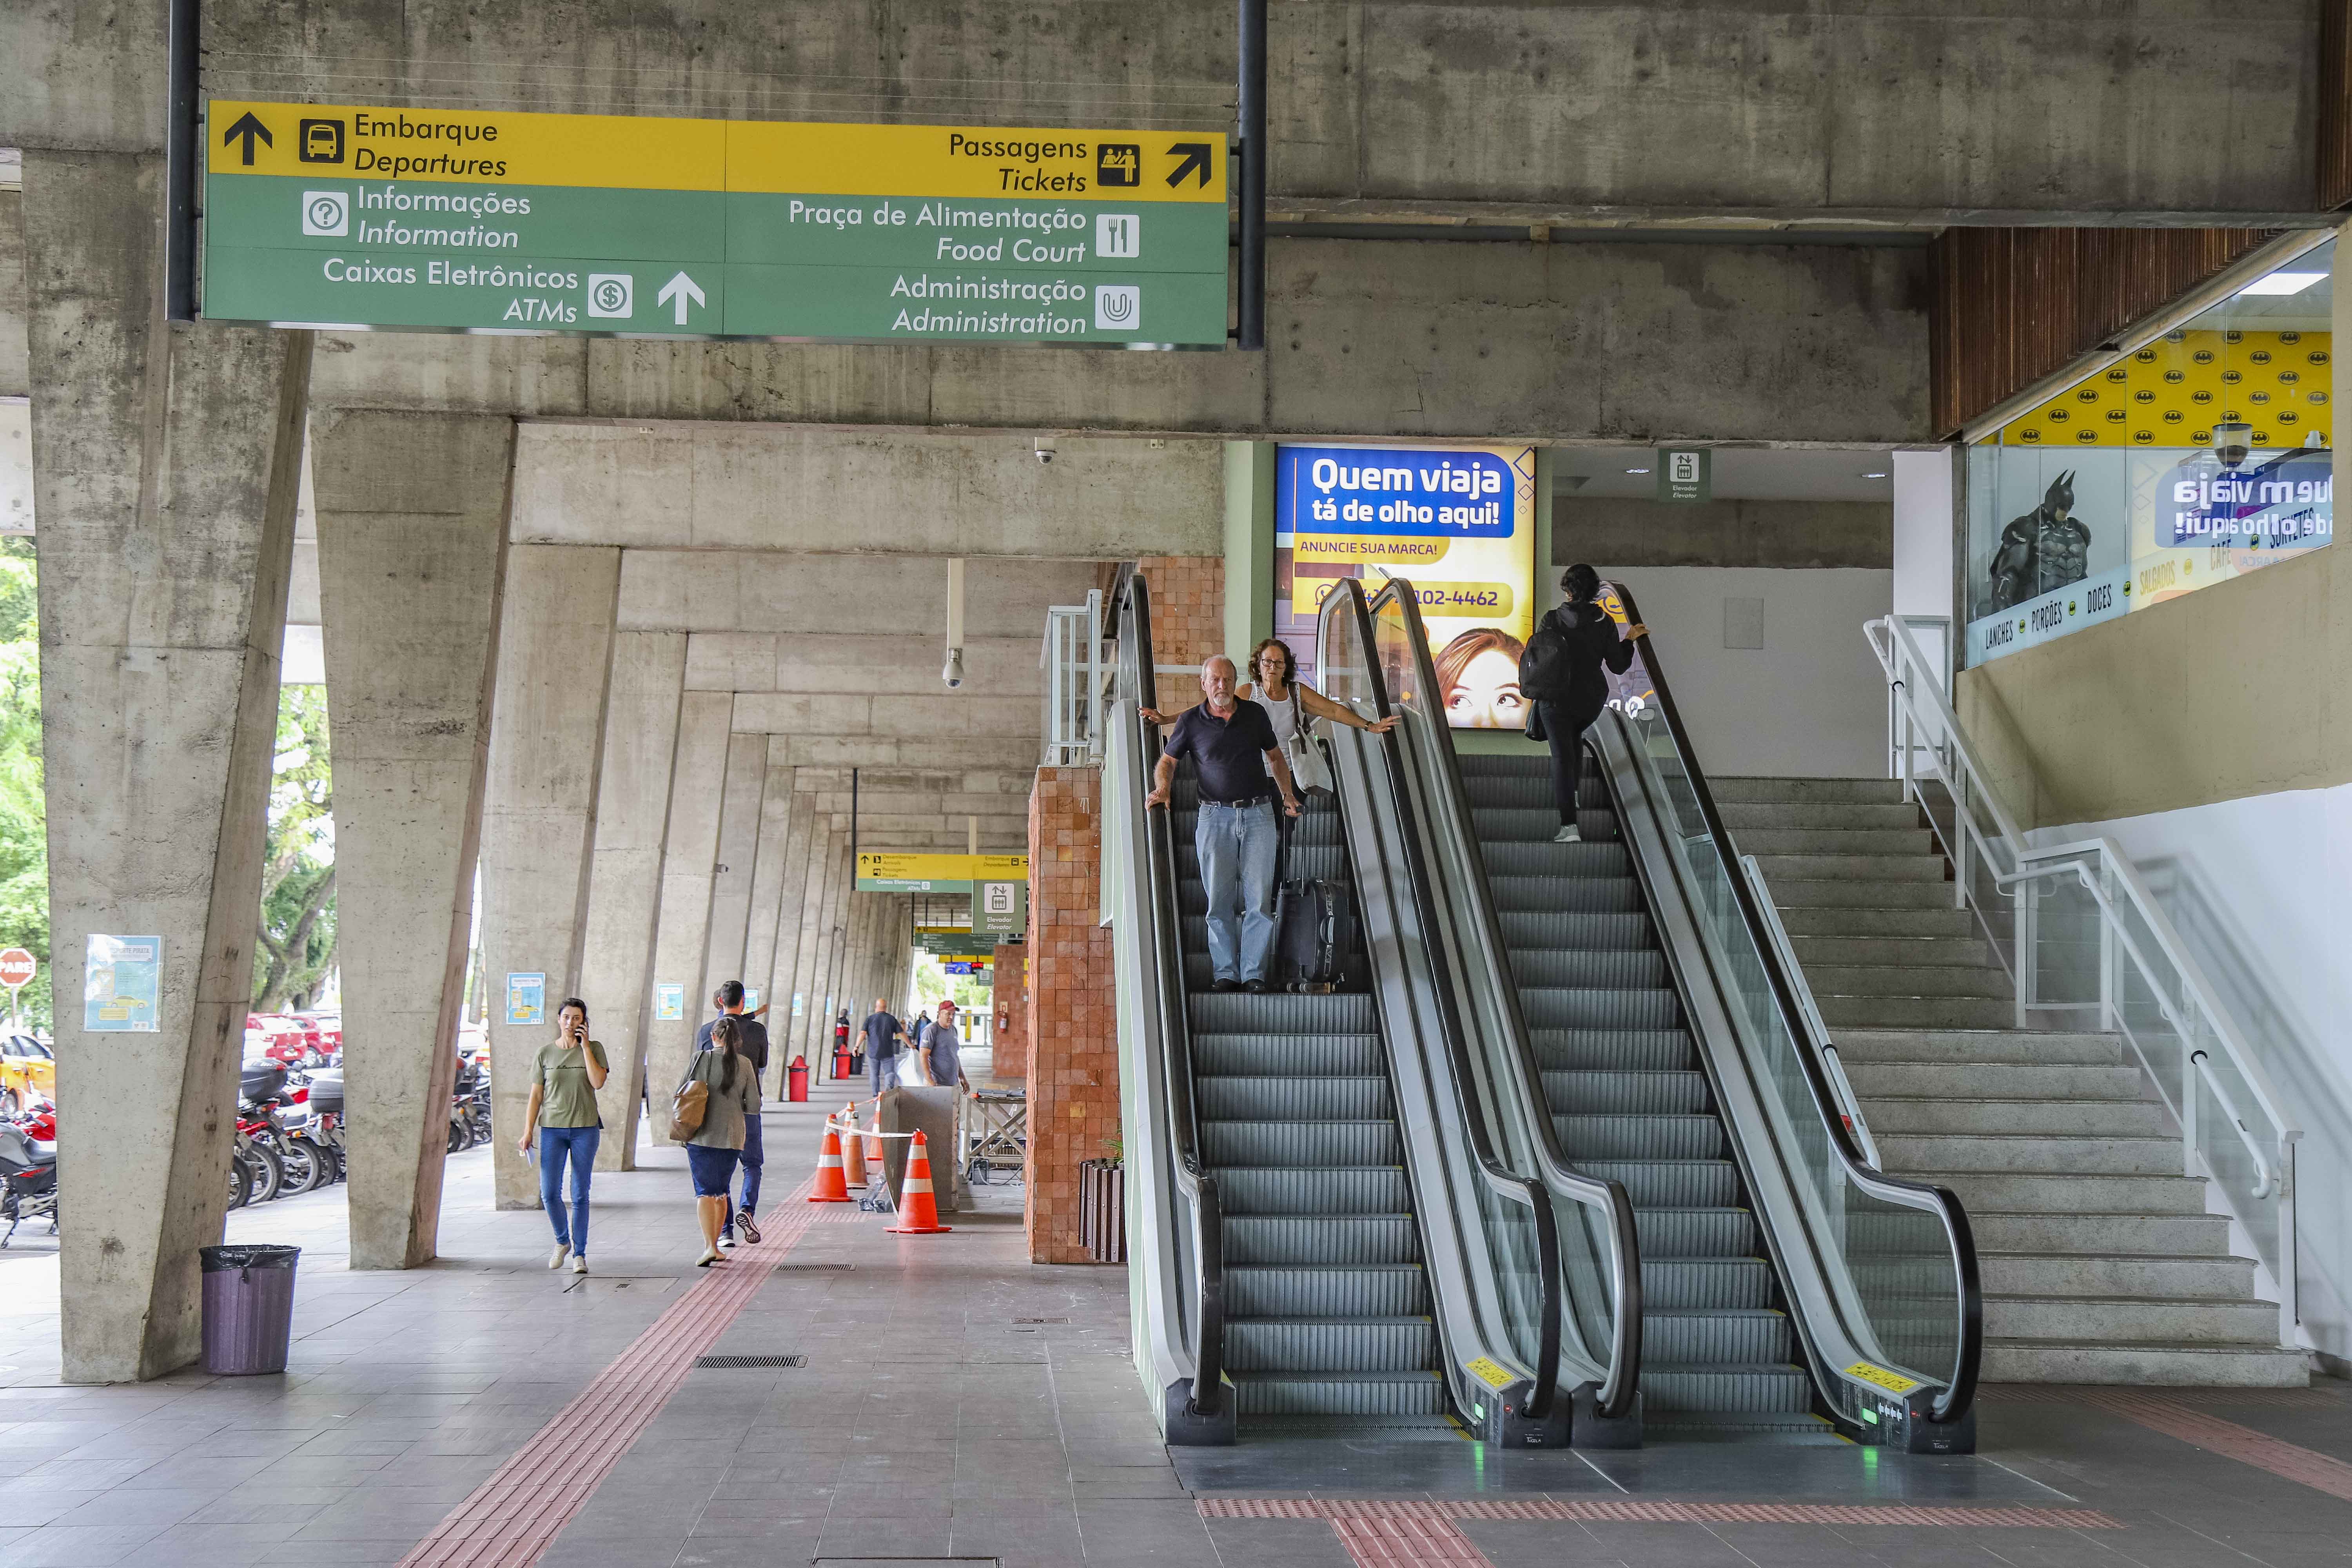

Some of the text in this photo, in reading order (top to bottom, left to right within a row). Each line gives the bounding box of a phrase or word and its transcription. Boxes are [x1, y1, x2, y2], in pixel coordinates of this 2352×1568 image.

[355, 114, 498, 146] Embarque
[950, 134, 1087, 163] Passagens
[355, 149, 507, 178] Departures
[999, 168, 1087, 192] Tickets
[358, 185, 531, 218] Informações
[790, 200, 1087, 235] Praça de Alimentação
[358, 220, 519, 249] Information
[936, 238, 1086, 263] Food Court
[324, 258, 578, 290] Caixas Eletrônicos
[891, 274, 1086, 306] Administração
[503, 298, 577, 323] ATMs
[892, 308, 1086, 335] Administration
[1312, 458, 1501, 500] Quem viaja
[1312, 498, 1499, 529] tá de olho aqui!
[1300, 541, 1437, 555] ANUNCIE SUA MARCA!
[1414, 590, 1497, 606] 102-4462
[1986, 619, 2013, 650] LANCHES
[2032, 600, 2062, 633] PORÇÕES
[2088, 583, 2111, 614] DOCES
[2140, 560, 2175, 596] SALGADOS
[0, 962, 32, 973] PARE
